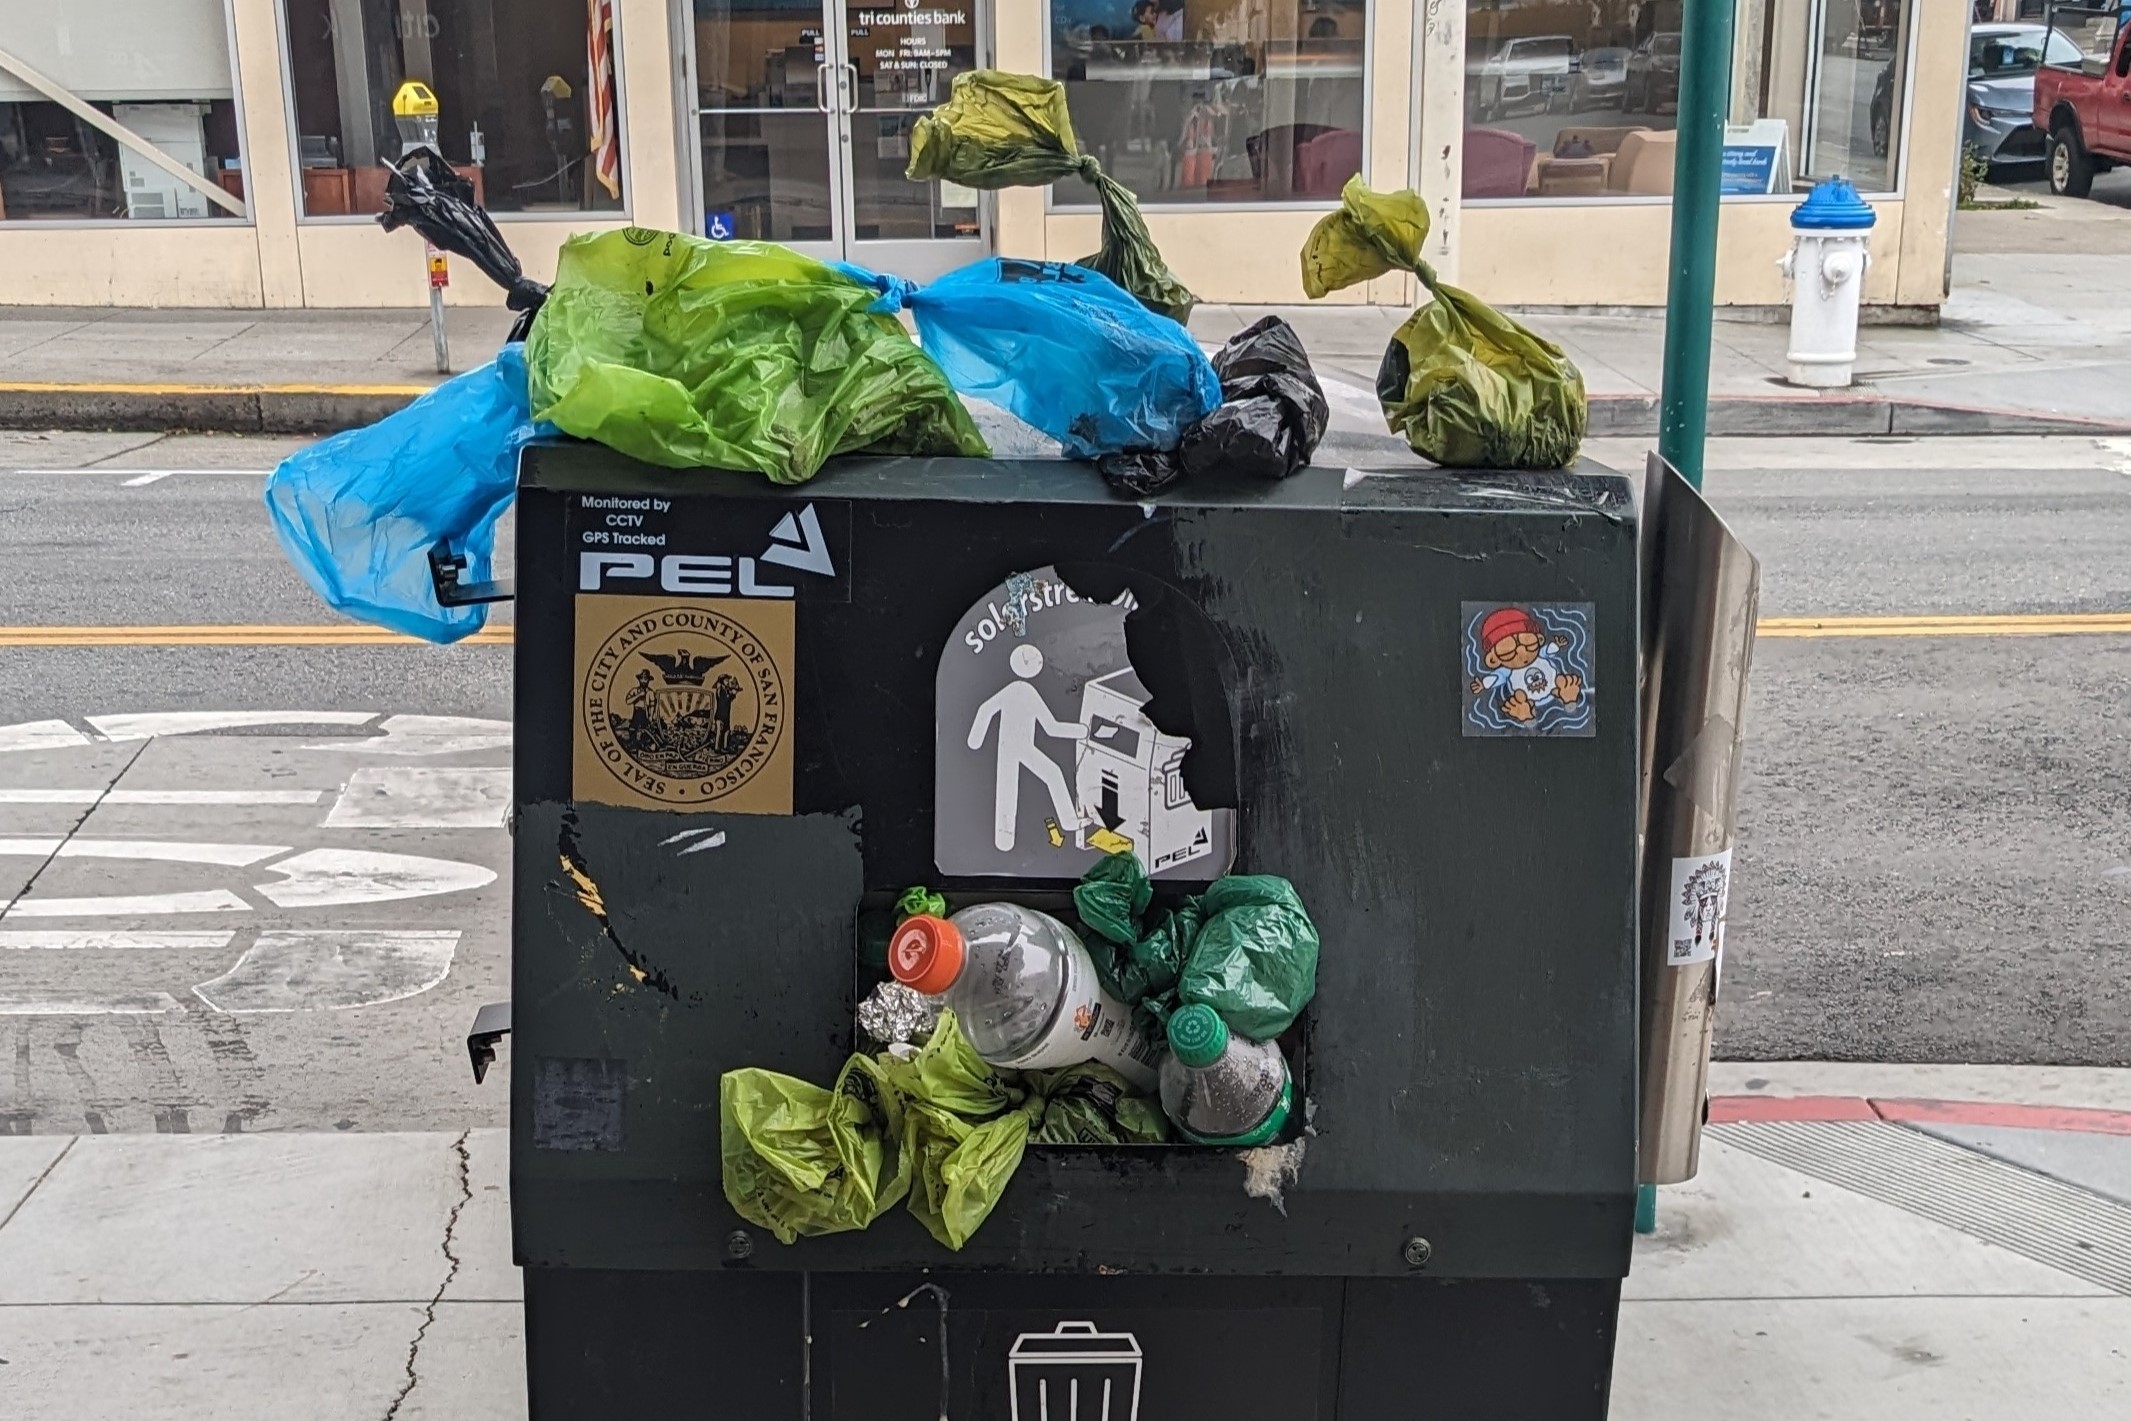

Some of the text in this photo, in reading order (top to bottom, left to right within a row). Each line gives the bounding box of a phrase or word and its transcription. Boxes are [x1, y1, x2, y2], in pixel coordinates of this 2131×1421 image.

[859, 10, 966, 25] tri counties bank
[850, 28, 869, 36] PULL
[900, 37, 926, 45] HOURS
[875, 48, 895, 57] MON
[880, 61, 893, 69] SAT
[920, 61, 948, 69] CLOSED
[581, 496, 671, 512] Monitored by
[605, 514, 644, 527] CCTV
[582, 531, 666, 546] GPS Tracked
[579, 551, 795, 597] PEL
[590, 613, 778, 796] SEAL OF THE CITY AND COUNTY OF SAN FRANCISCO
